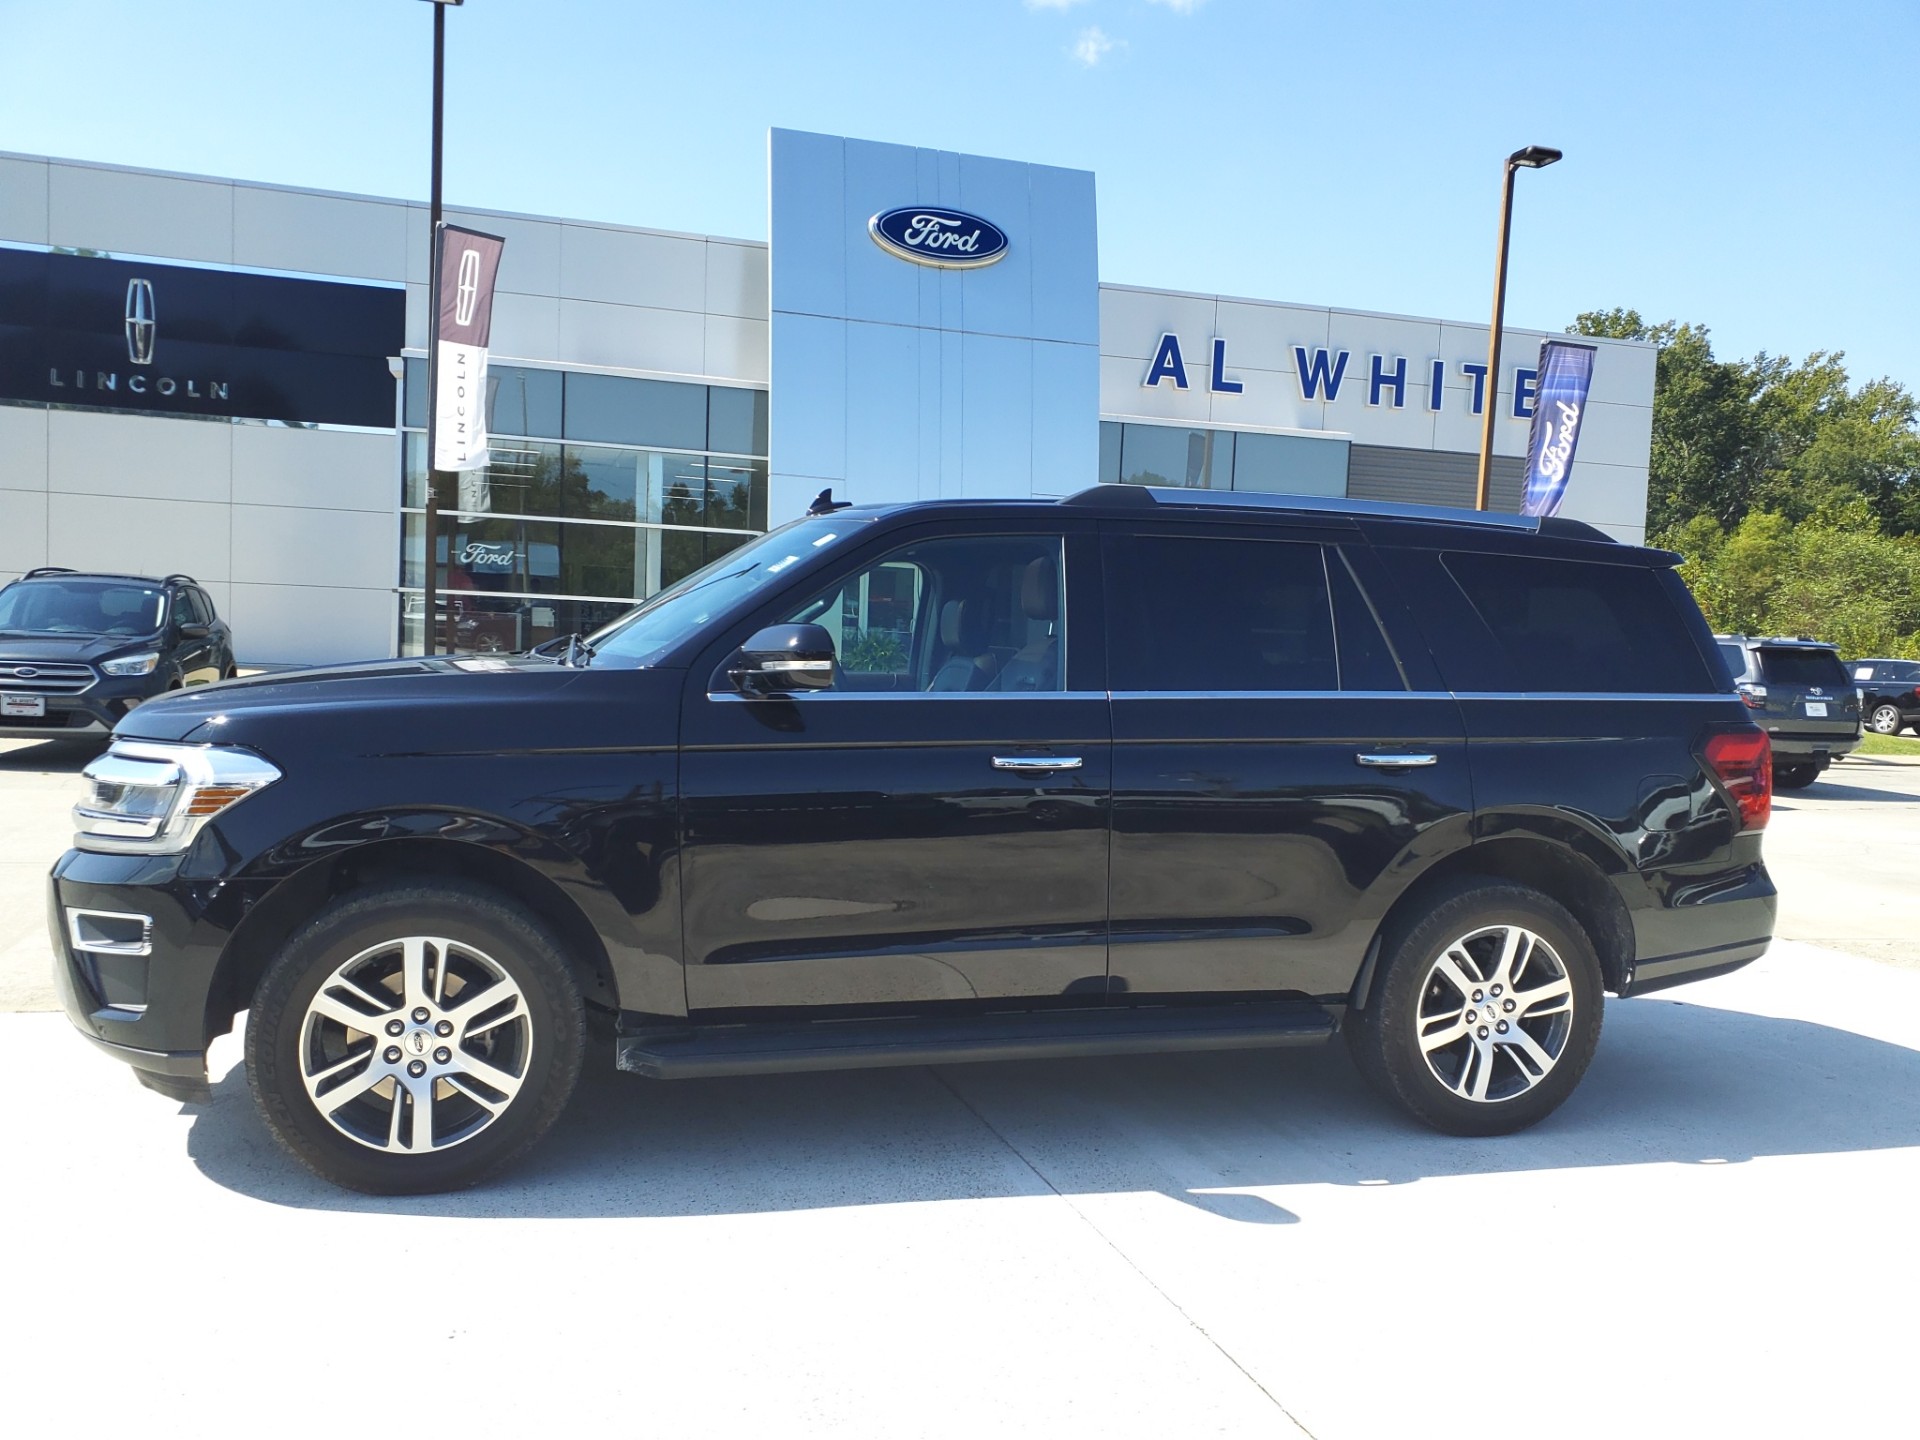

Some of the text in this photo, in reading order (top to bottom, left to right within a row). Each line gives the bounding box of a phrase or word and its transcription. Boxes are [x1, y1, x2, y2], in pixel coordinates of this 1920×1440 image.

[904, 214, 981, 251] Ford
[50, 367, 229, 399] LINCOLN
[1143, 333, 1536, 419] AL WHITE
[457, 353, 466, 461] LINCOLN
[1540, 400, 1579, 482] Ford
[460, 542, 514, 565] Ford
